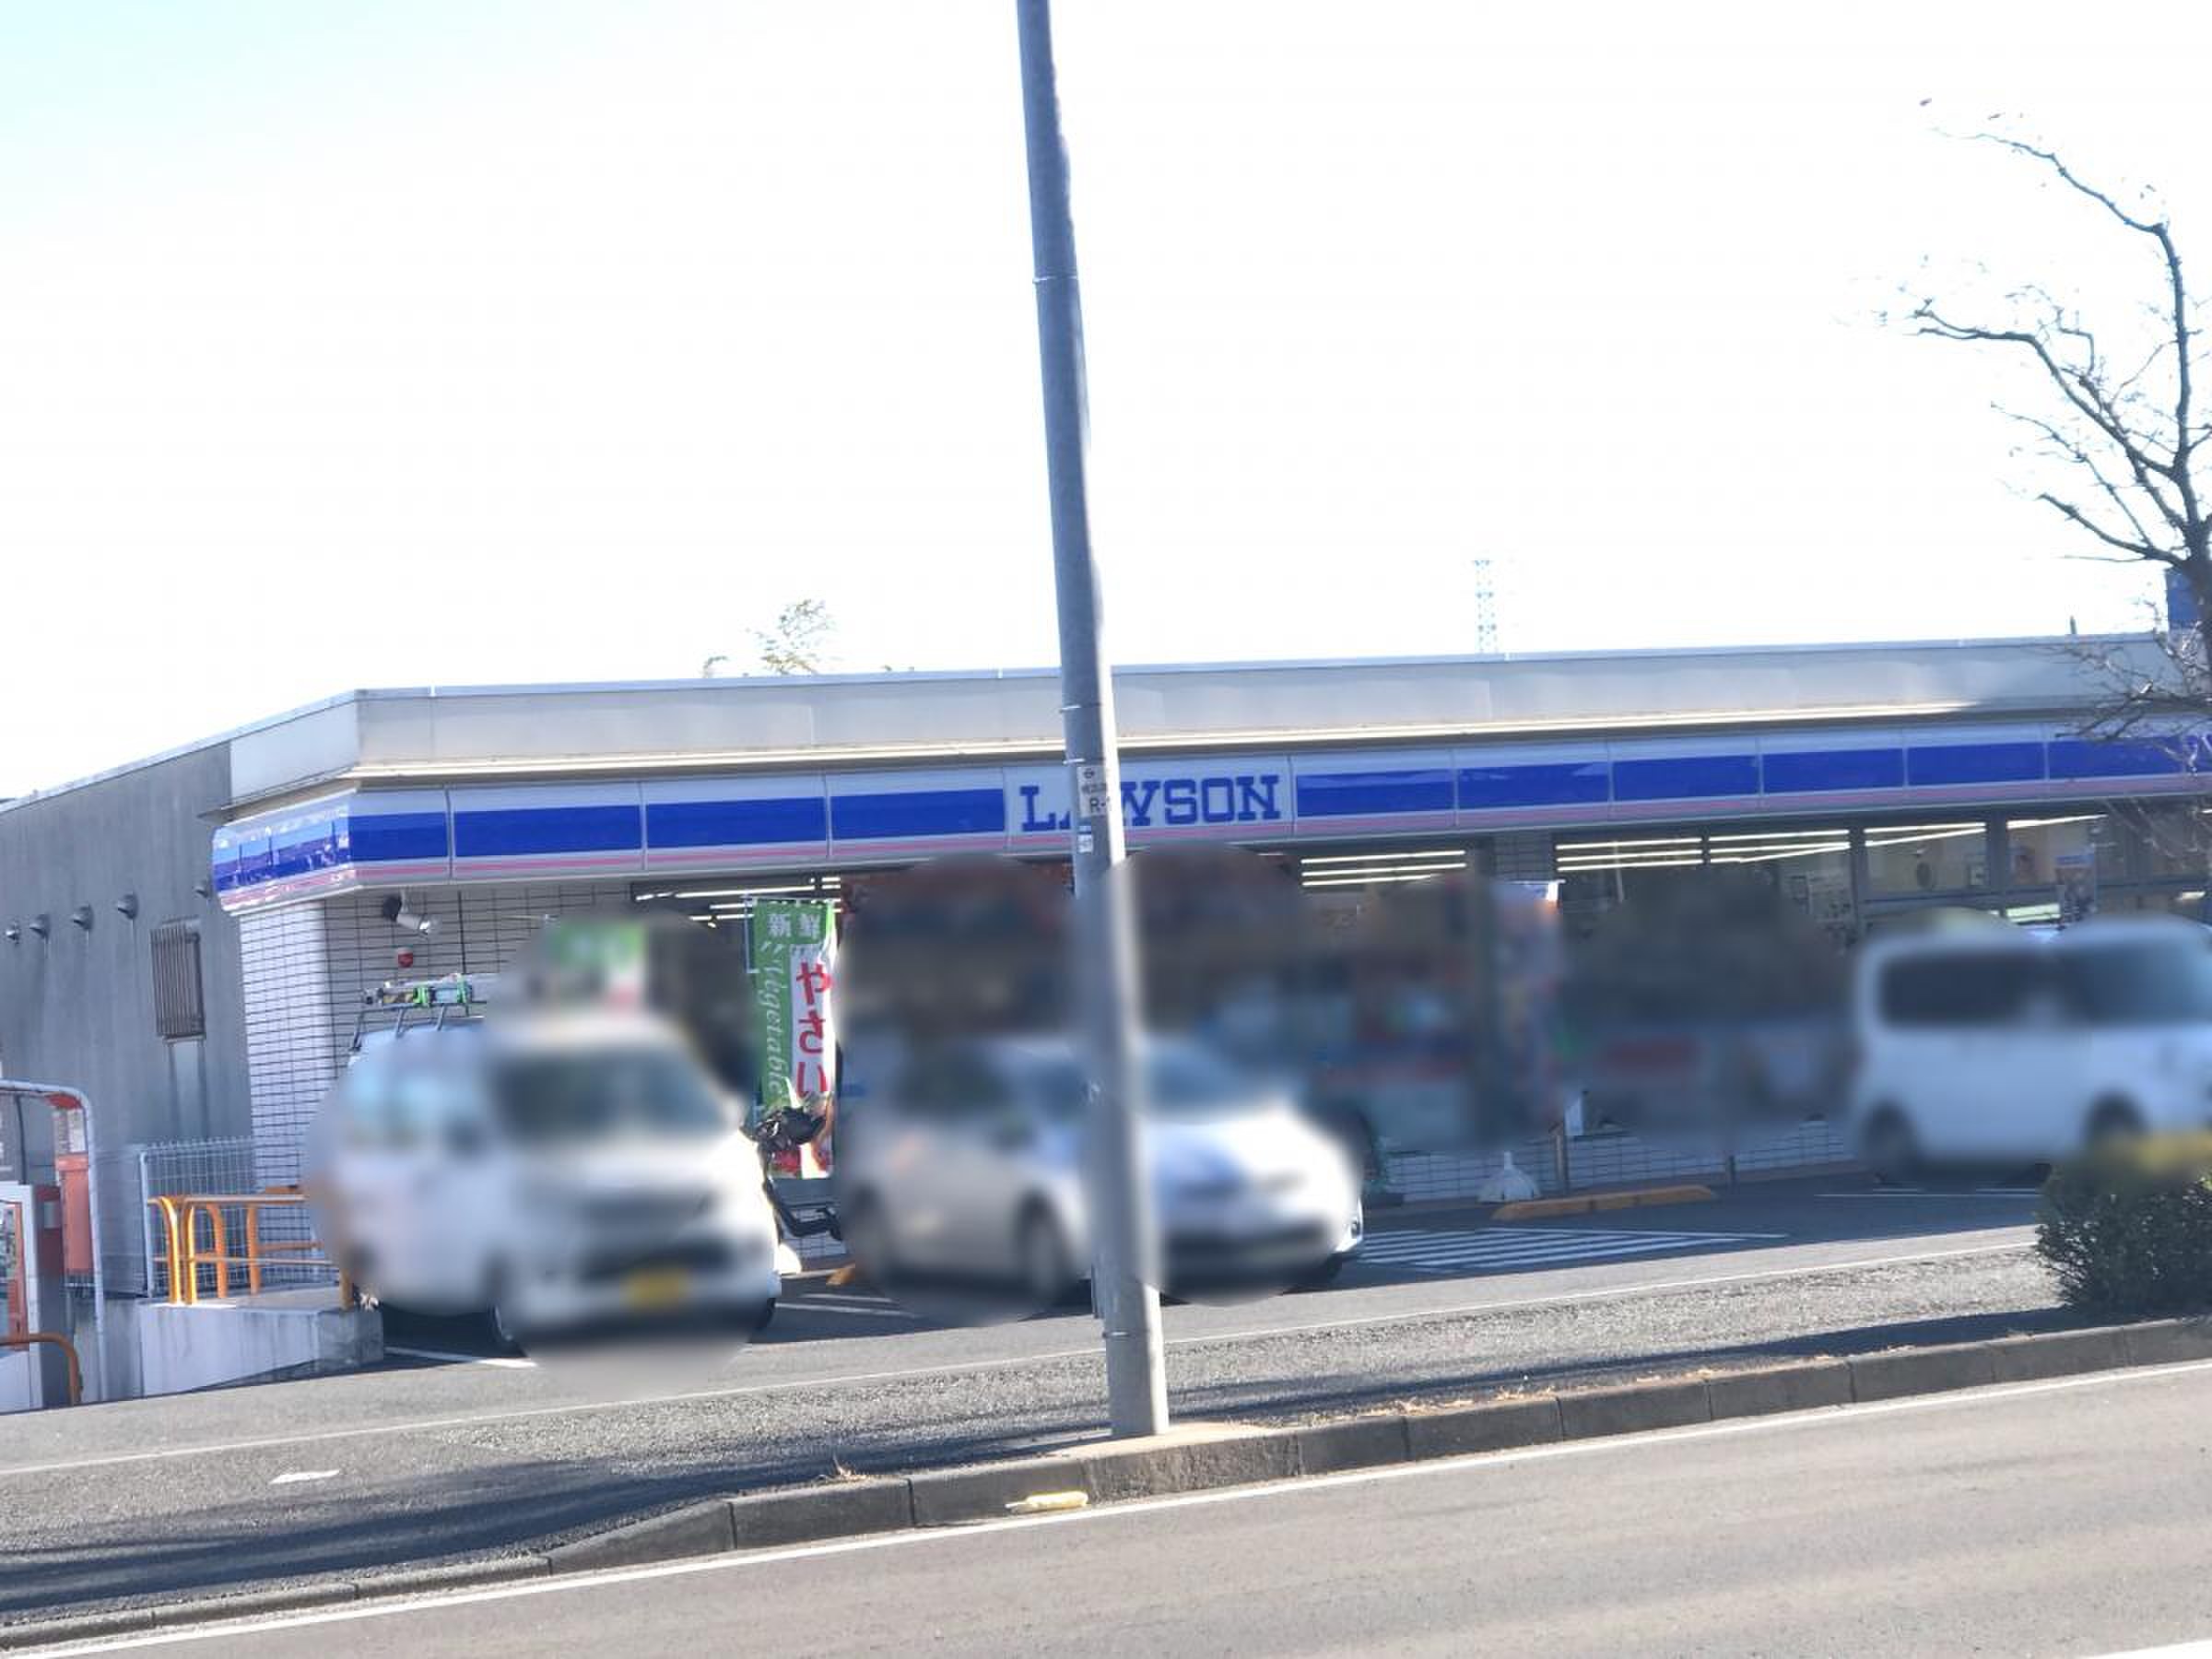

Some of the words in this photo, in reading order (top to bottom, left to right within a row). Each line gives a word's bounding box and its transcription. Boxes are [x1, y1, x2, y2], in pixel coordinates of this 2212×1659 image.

[1019, 775, 1282, 830] LWSON
[795, 961, 834, 1098] やさい
